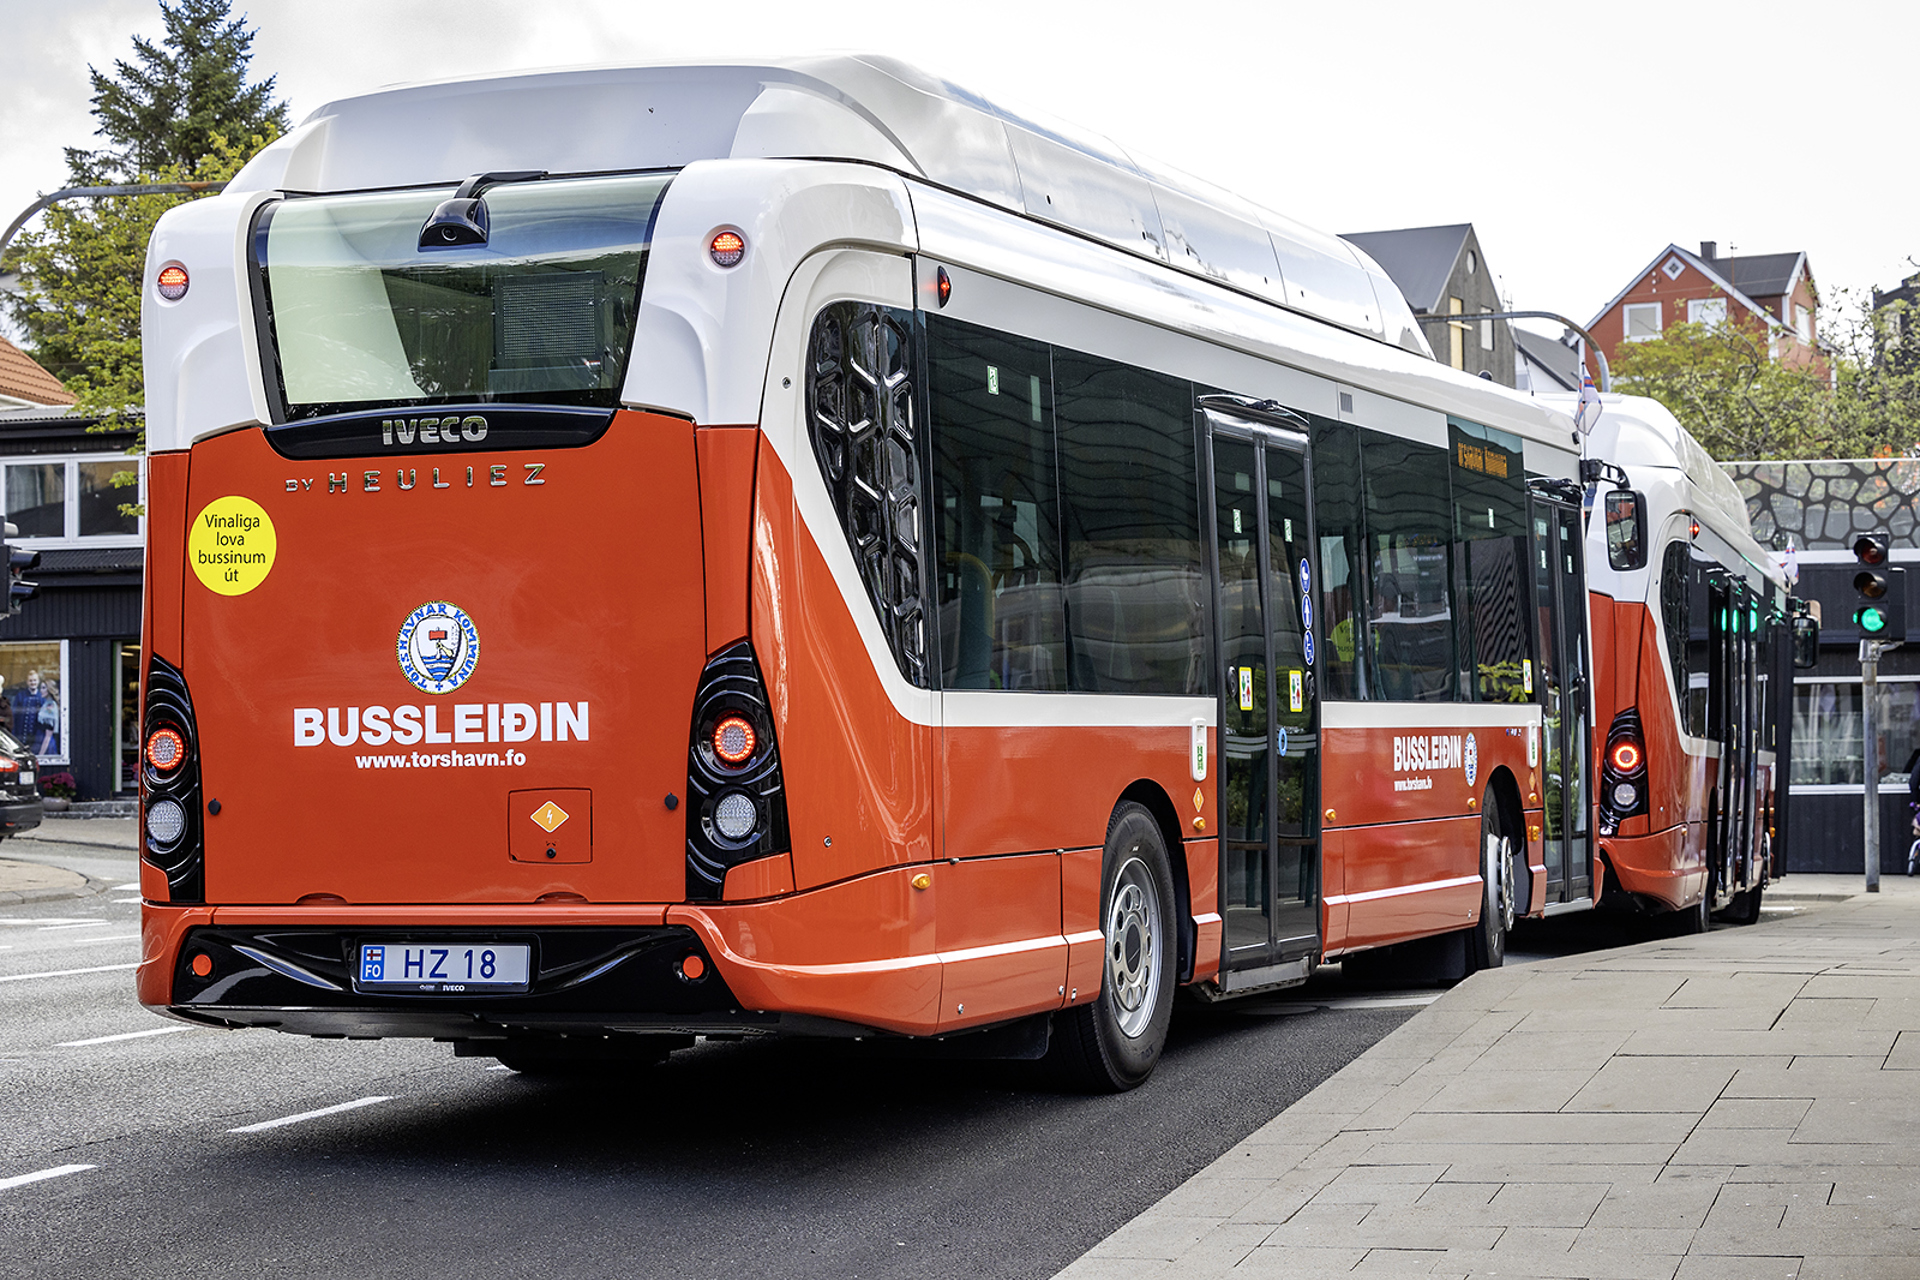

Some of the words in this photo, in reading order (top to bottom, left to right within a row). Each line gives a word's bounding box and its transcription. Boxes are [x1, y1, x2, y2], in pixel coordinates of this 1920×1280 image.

[382, 415, 488, 445] IVECO
[285, 478, 314, 492] BY
[329, 463, 546, 493] HEULIEZ
[204, 513, 260, 532] Vinaliga
[216, 532, 245, 546] lova
[198, 549, 266, 564] bussinum
[224, 567, 239, 582] út
[449, 610, 477, 687] KOMMUNA
[294, 701, 589, 747] BUSSLEIÐIN
[355, 749, 526, 769] www.torshavn.fo
[1393, 735, 1462, 772] BUSSLEIÐIN
[365, 964, 381, 978] FO
[404, 949, 449, 979] HZ
[463, 949, 496, 979] 18
